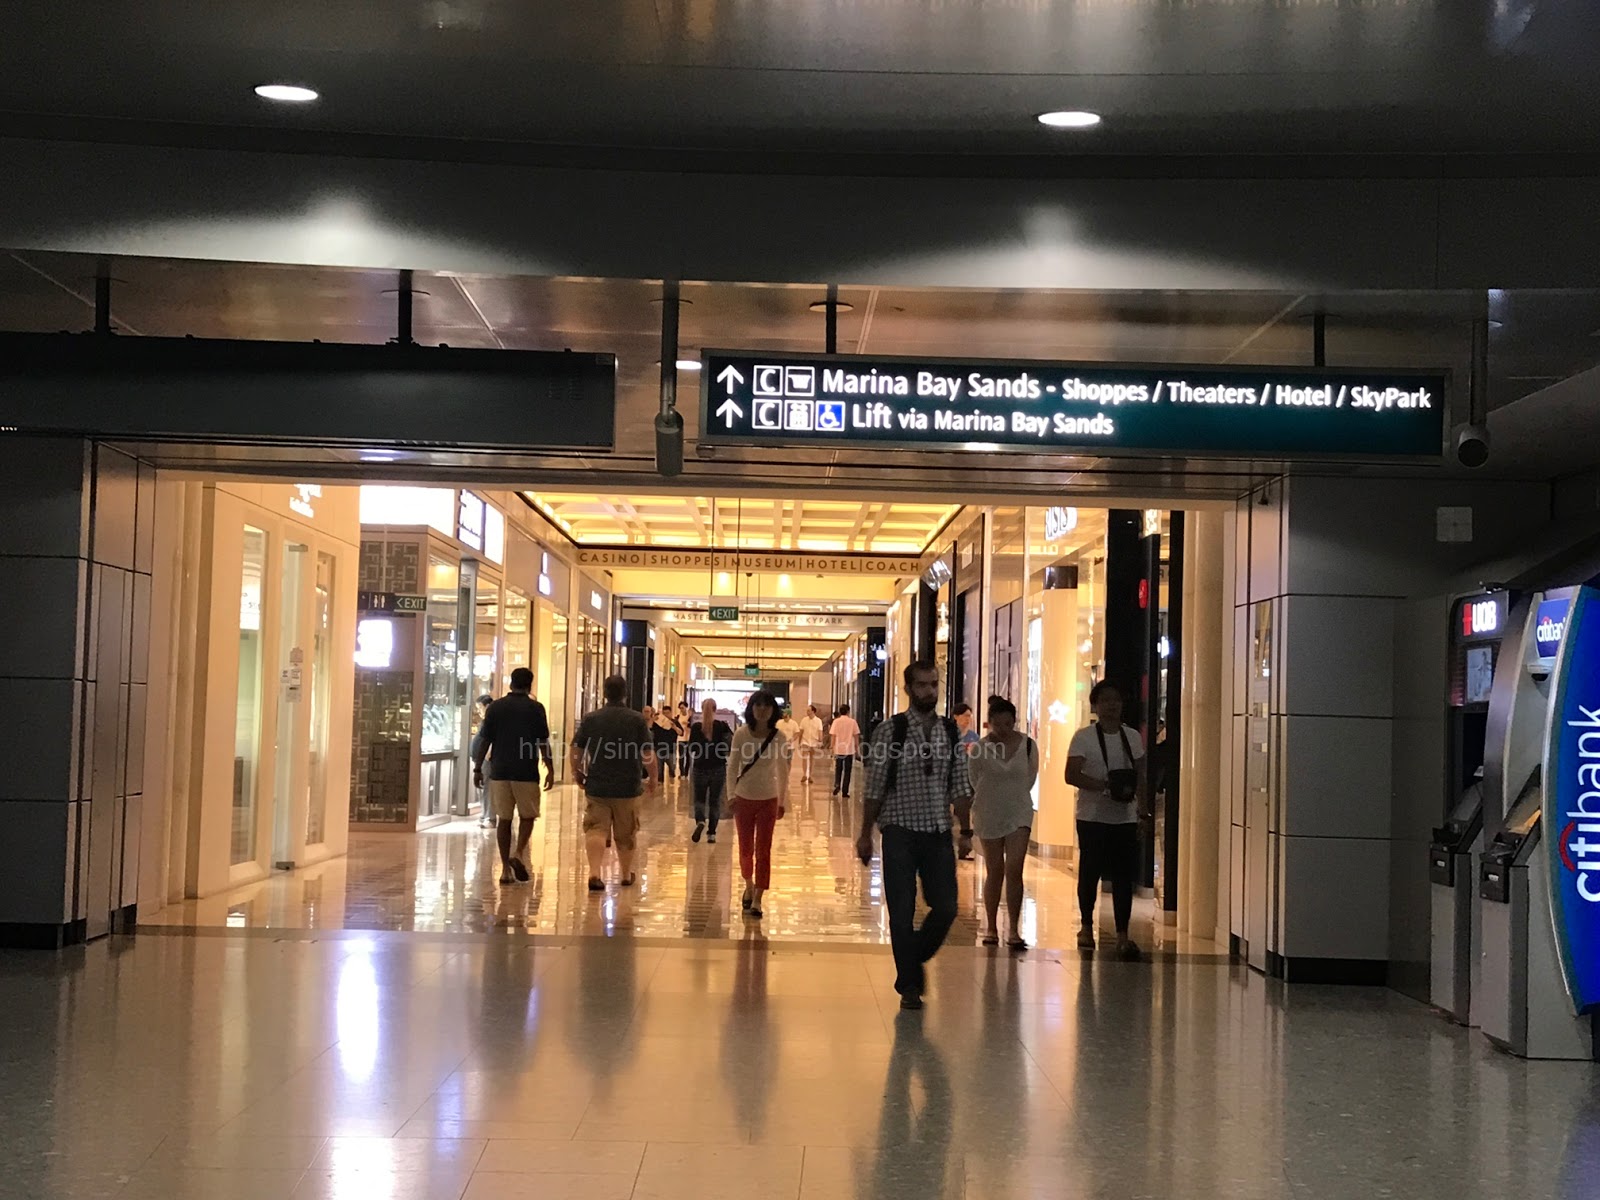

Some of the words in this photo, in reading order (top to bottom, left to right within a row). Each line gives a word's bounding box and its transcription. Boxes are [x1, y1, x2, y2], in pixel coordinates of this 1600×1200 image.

[823, 369, 909, 396] Marina
[917, 372, 962, 402] Bay
[968, 373, 1042, 400] Sands
[1062, 378, 1149, 405] Shoppes
[1167, 381, 1257, 405] Theaters
[1276, 384, 1332, 407] Hotel
[1351, 385, 1432, 412] SkyPark
[852, 402, 893, 430] Lift
[898, 408, 929, 430] via
[935, 409, 1006, 432] Marina
[1012, 412, 1050, 438] Bay
[1053, 412, 1115, 436] Sands
[579, 552, 641, 564] CASINO
[650, 554, 721, 566] SHOPPES
[731, 557, 796, 569] MUSEUM
[806, 559, 857, 570] HOTEL
[865, 561, 919, 572] COACH
[404, 597, 425, 609] EXIT
[716, 608, 737, 619] EXIT
[741, 615, 792, 624] THEATRES
[801, 616, 843, 625] KYPARK
[1472, 601, 1497, 633] UOB
[1567, 705, 1600, 902] citibank
